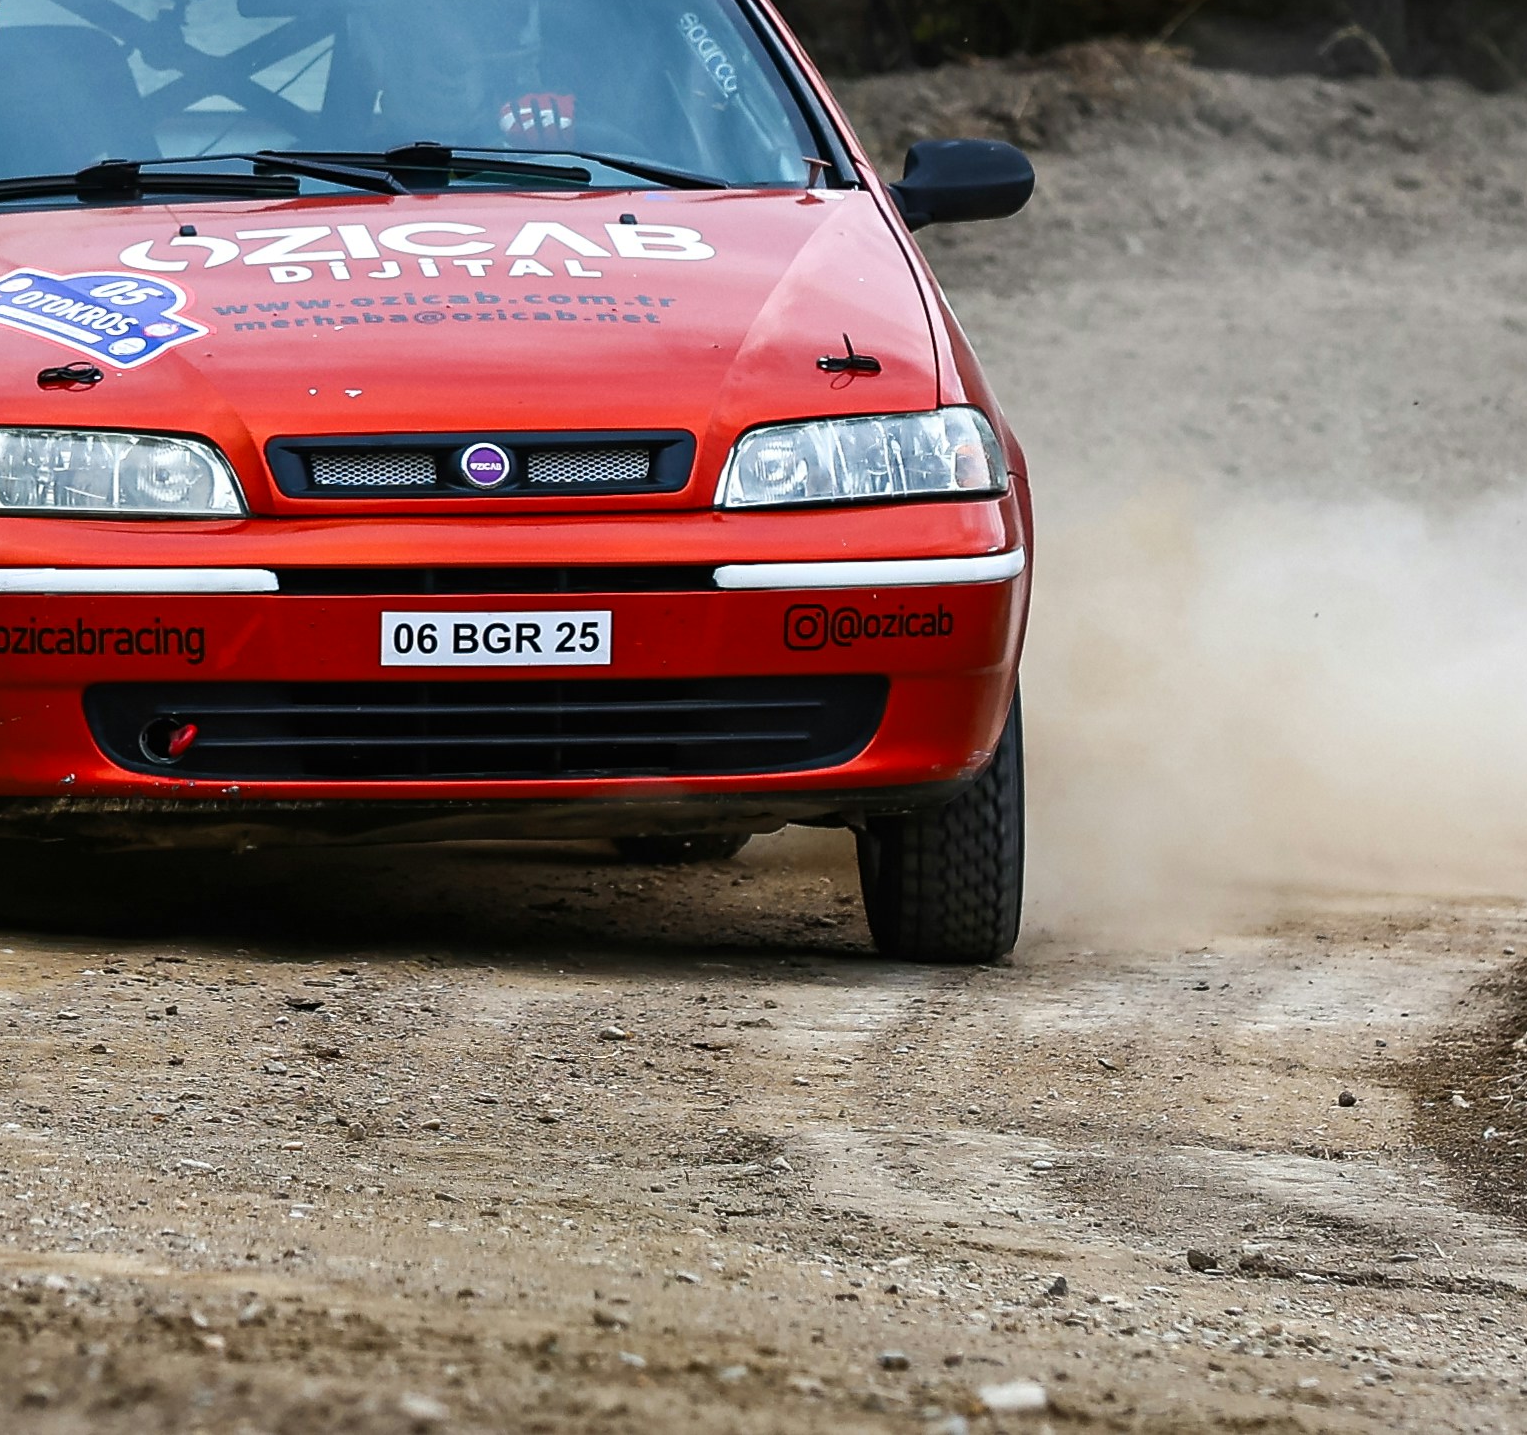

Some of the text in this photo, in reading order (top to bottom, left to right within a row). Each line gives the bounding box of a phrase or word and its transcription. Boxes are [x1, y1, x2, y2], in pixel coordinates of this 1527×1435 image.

[119, 221, 716, 272] OZICAB
[89, 270, 164, 305] 05
[212, 291, 677, 316] www.ozicab.com.tr
[11, 280, 139, 336] OTOKROS
[234, 309, 661, 332] merhaba@ozicab.net
[393, 621, 600, 654] 06 BGR 25
[830, 603, 954, 647] @ozicab
